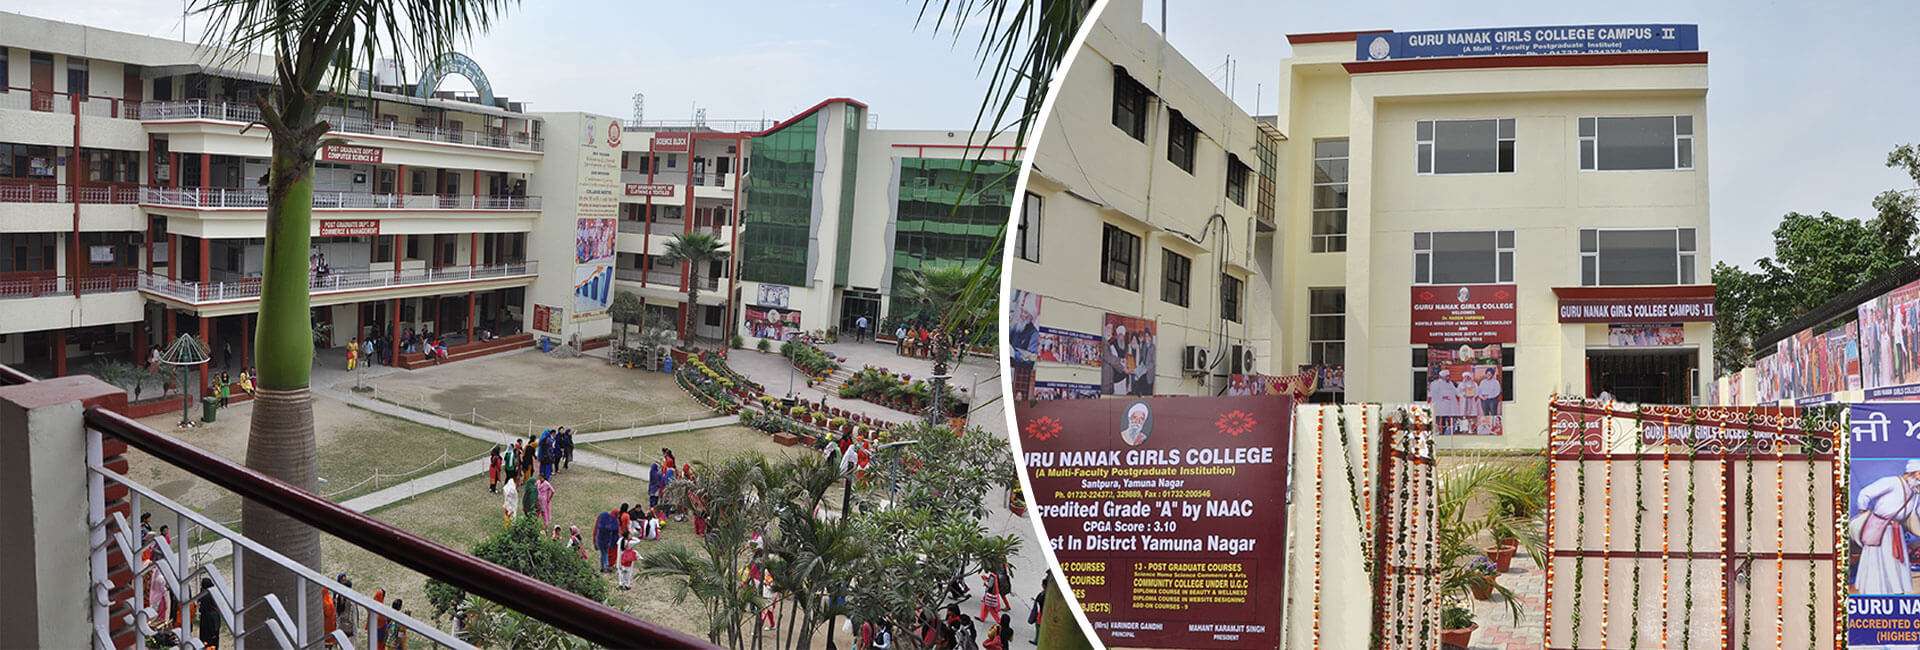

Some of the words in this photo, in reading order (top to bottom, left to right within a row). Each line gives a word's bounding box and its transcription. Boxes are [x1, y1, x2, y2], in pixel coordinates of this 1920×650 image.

[1409, 34, 1443, 46] GURU
[1448, 32, 1491, 45] NANAK
[1495, 30, 1531, 43] GIRLS
[1535, 29, 1595, 41] COLLEGE
[1598, 28, 1652, 40] CAMPUS
[1533, 42, 1583, 50] Postgraduate
[1560, 305, 1581, 318] GURU
[1583, 305, 1609, 318] NANAK
[1610, 304, 1632, 317] GIRLS
[1634, 304, 1667, 317] COLLEGE
[1668, 304, 1700, 317] CAMPUS
[1060, 451, 1121, 467] NANAK
[1126, 449, 1180, 466] GIRLS
[1186, 447, 1273, 465] COLLEGE
[1036, 469, 1045, 478] (A
[1048, 468, 1109, 478] Multi-Faculty
[1111, 467, 1177, 477] Postgraduate
[1180, 466, 1236, 476] Institution)
[1081, 479, 1121, 490] Santpura,
[1123, 479, 1156, 488] Yamuna
[1158, 478, 1184, 489] Nagar
[1037, 501, 1099, 517] credited
[1103, 501, 1151, 517] Grade
[1155, 500, 1178, 517] "A"
[1182, 501, 1201, 522] by
[1206, 500, 1253, 517] NAAC
[1083, 521, 1112, 532] CPGA
[1114, 521, 1145, 532] Score
[1153, 521, 1177, 532] 3.10
[1068, 535, 1081, 550] In
[1086, 535, 1137, 550] Distrct
[1141, 535, 1202, 551] Yamuna
[1207, 535, 1256, 555] Nagar
[1070, 562, 1106, 572] COURSES
[1148, 563, 1167, 571] POST
[1168, 563, 1206, 572] GRADUATE
[1207, 563, 1242, 572] COURSES
[1070, 576, 1105, 585] COURSES
[1133, 578, 1172, 587] COMMUNITY
[1174, 579, 1204, 588] COLLEGE
[1205, 579, 1229, 588] UNDER
[1847, 599, 1893, 615] GURU
[1849, 619, 1911, 629] ACCREDITED
